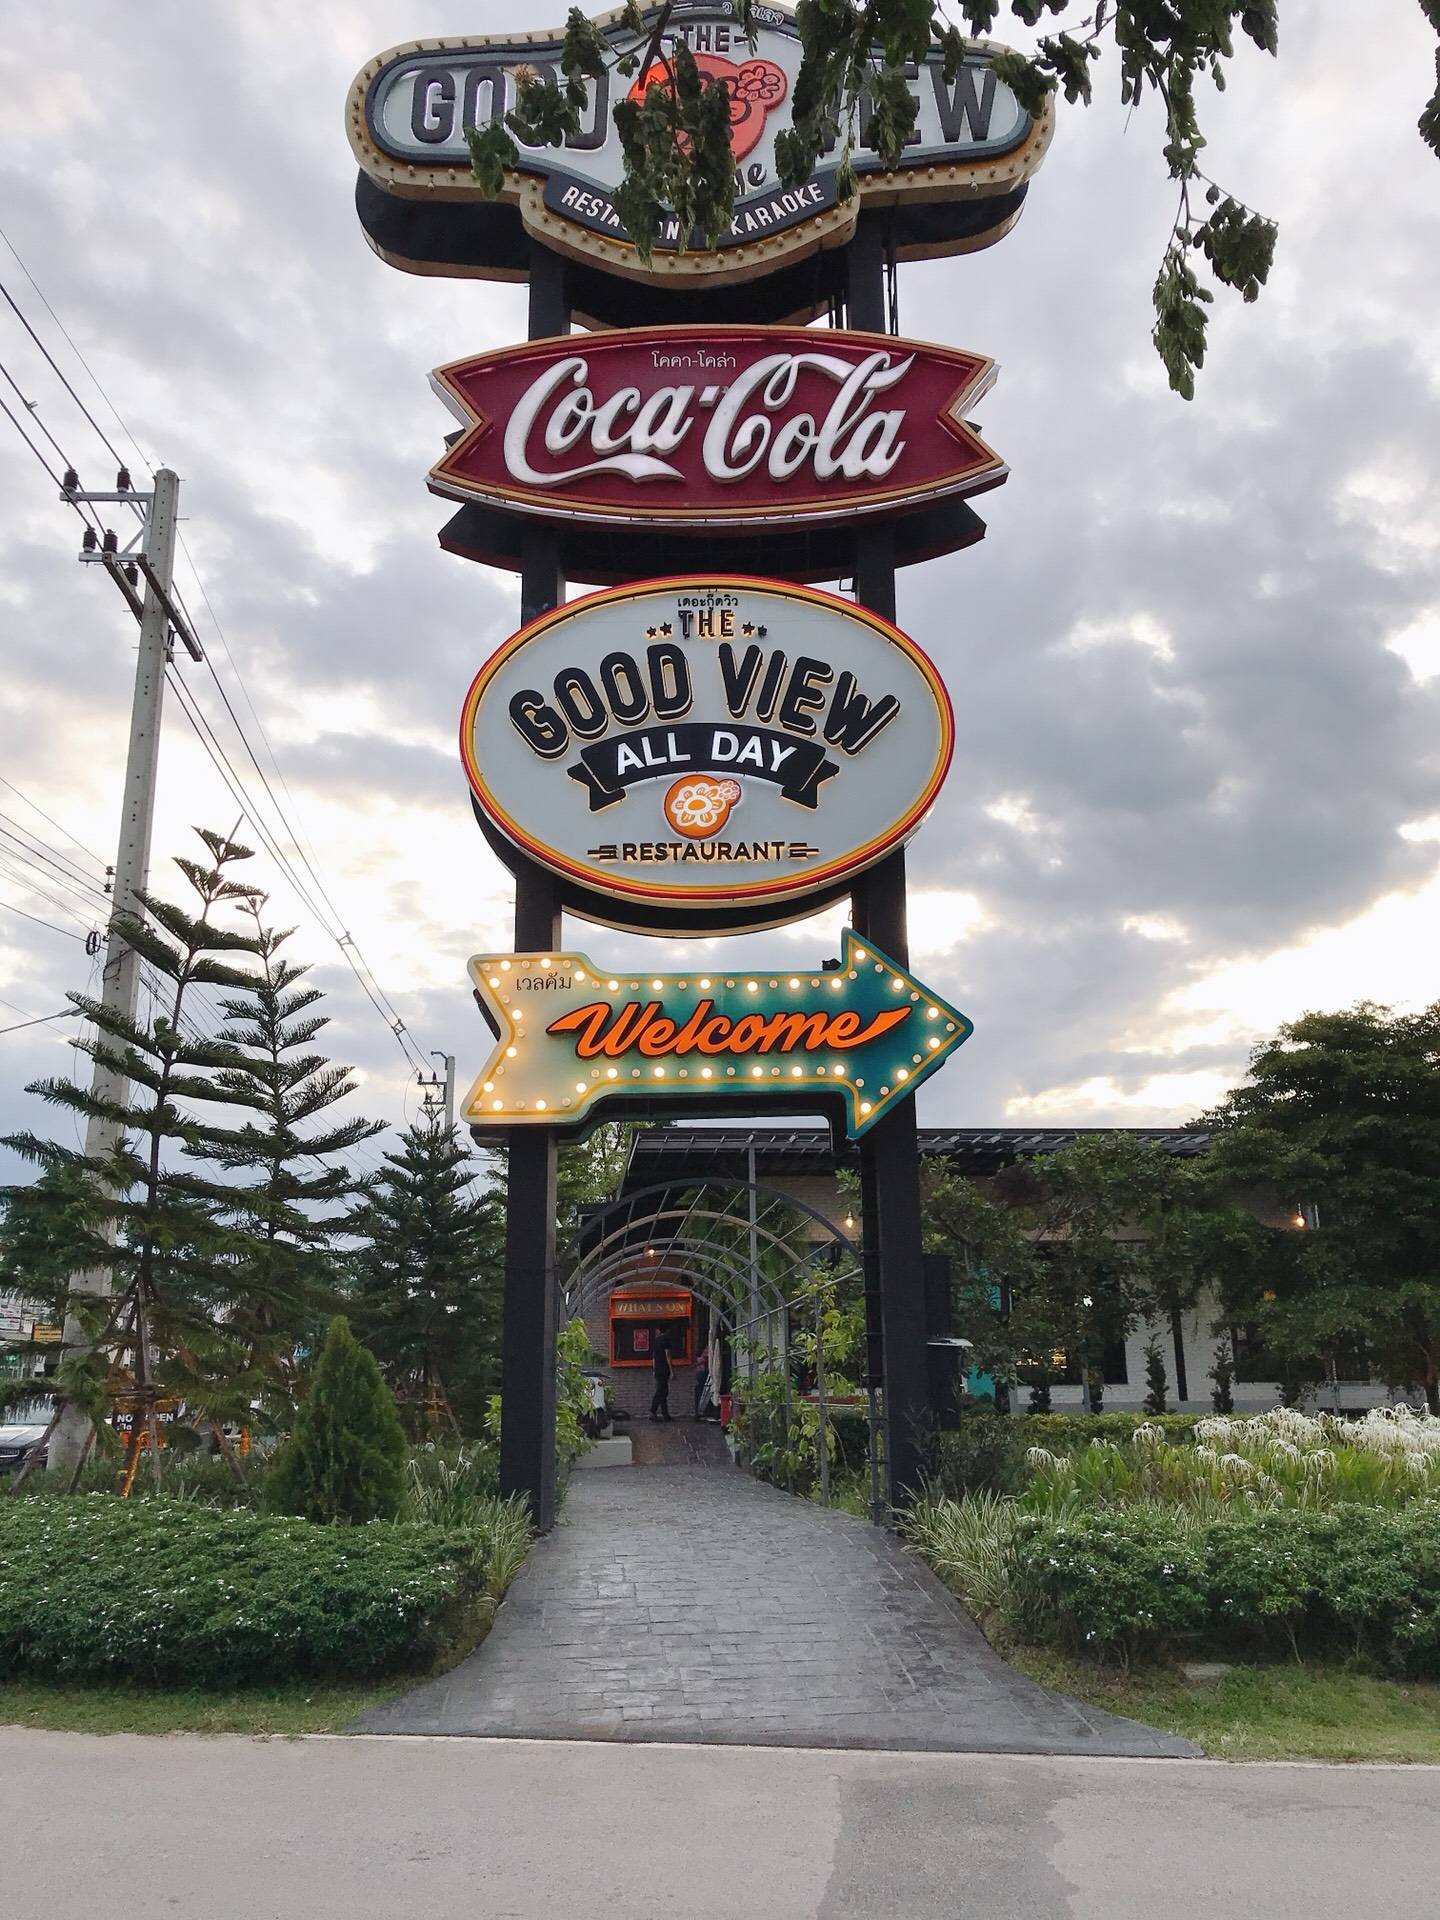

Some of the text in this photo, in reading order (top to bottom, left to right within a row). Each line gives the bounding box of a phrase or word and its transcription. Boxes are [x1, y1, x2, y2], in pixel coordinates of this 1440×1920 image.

[680, 25, 730, 52] THE
[730, 183, 825, 236] KARAOKE
[651, 350, 736, 368] โคคา-โคล่า
[503, 351, 916, 485] Coca-Cola
[678, 609, 735, 639] THE
[509, 642, 901, 760] GOOD VIEW
[616, 730, 799, 777] ALL DAY
[622, 841, 786, 862] RESTAURANT
[516, 971, 572, 991] เวลคัม
[546, 999, 913, 1058] Welcome
